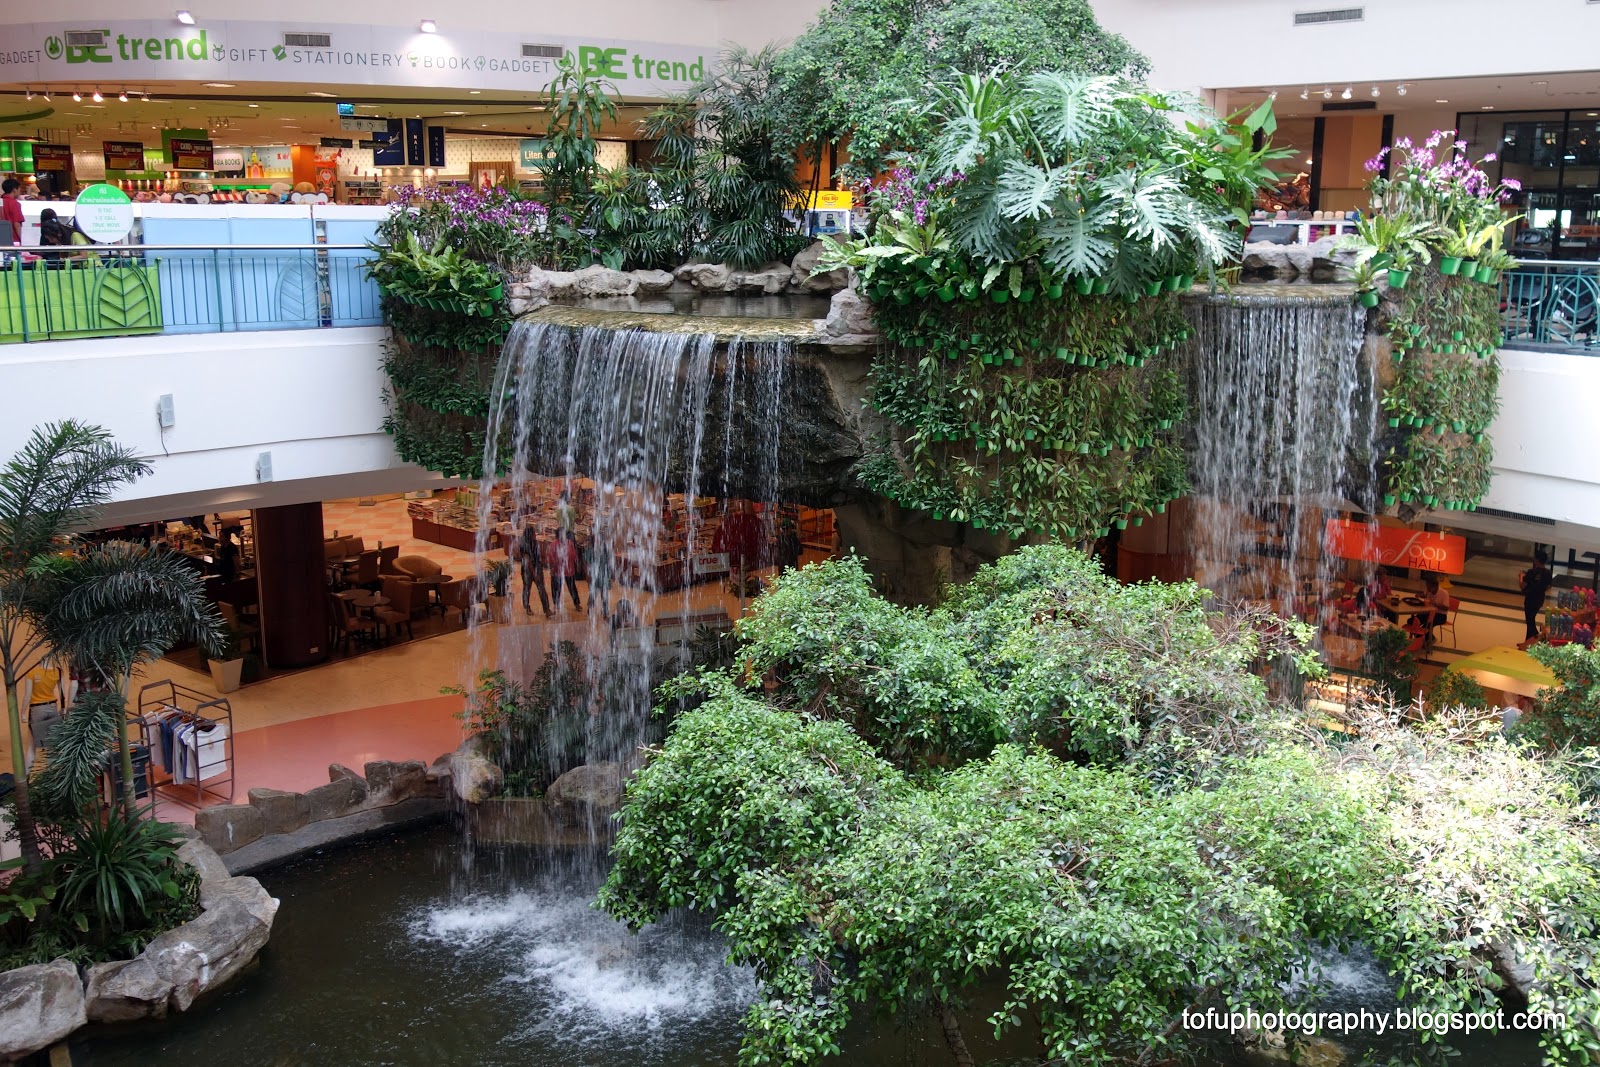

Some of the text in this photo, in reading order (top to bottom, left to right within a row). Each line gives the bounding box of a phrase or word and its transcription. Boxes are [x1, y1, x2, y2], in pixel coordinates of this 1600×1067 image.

[0, 50, 41, 64] GADGET
[116, 29, 209, 61] trend
[229, 48, 268, 62] GIFT
[292, 50, 402, 67] STATIONERY
[423, 55, 471, 69] BOOK
[489, 58, 551, 73] GADGET
[578, 45, 628, 80] BE
[632, 55, 704, 83] trend
[699, 557, 718, 565] true
[1408, 556, 1446, 572] HALL
